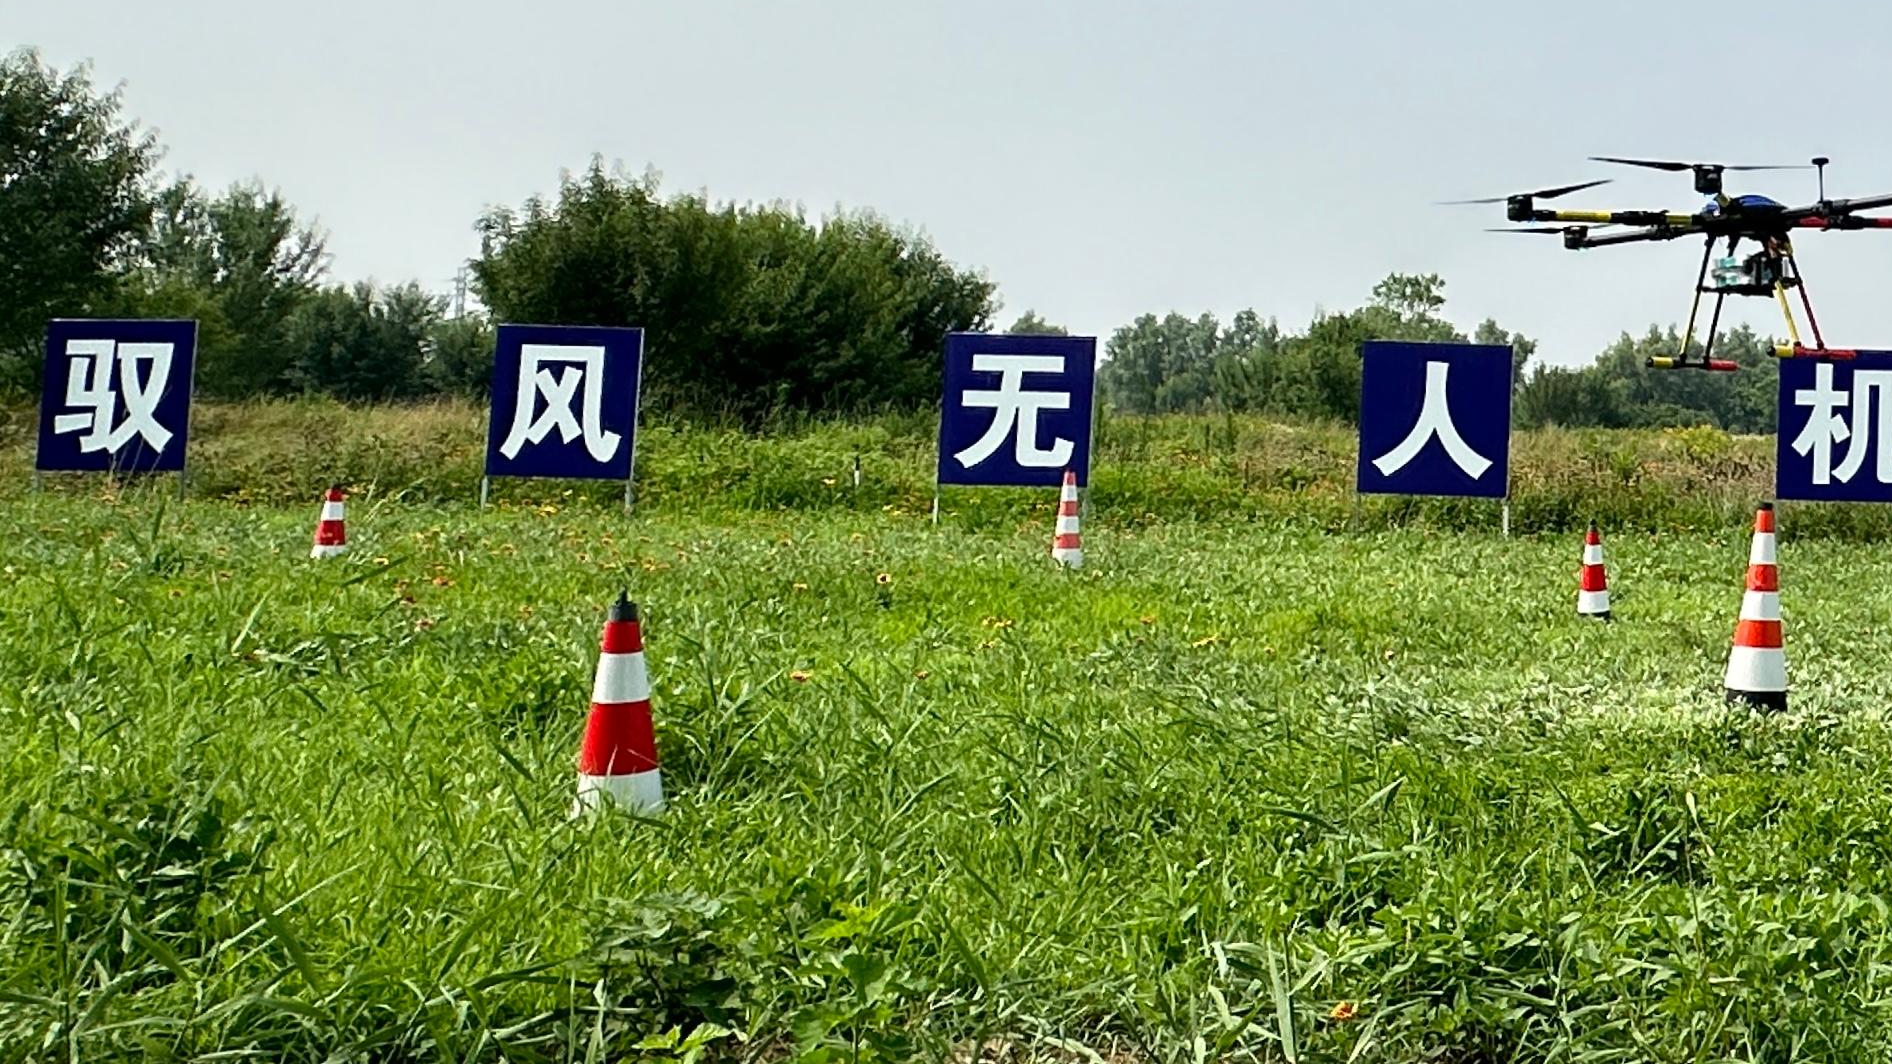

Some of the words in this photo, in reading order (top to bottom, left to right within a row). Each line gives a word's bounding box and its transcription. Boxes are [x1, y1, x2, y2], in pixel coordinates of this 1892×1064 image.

[54, 339, 175, 454] 驭
[499, 343, 622, 464] 风
[953, 354, 1076, 469] 无
[1372, 360, 1494, 481] 人
